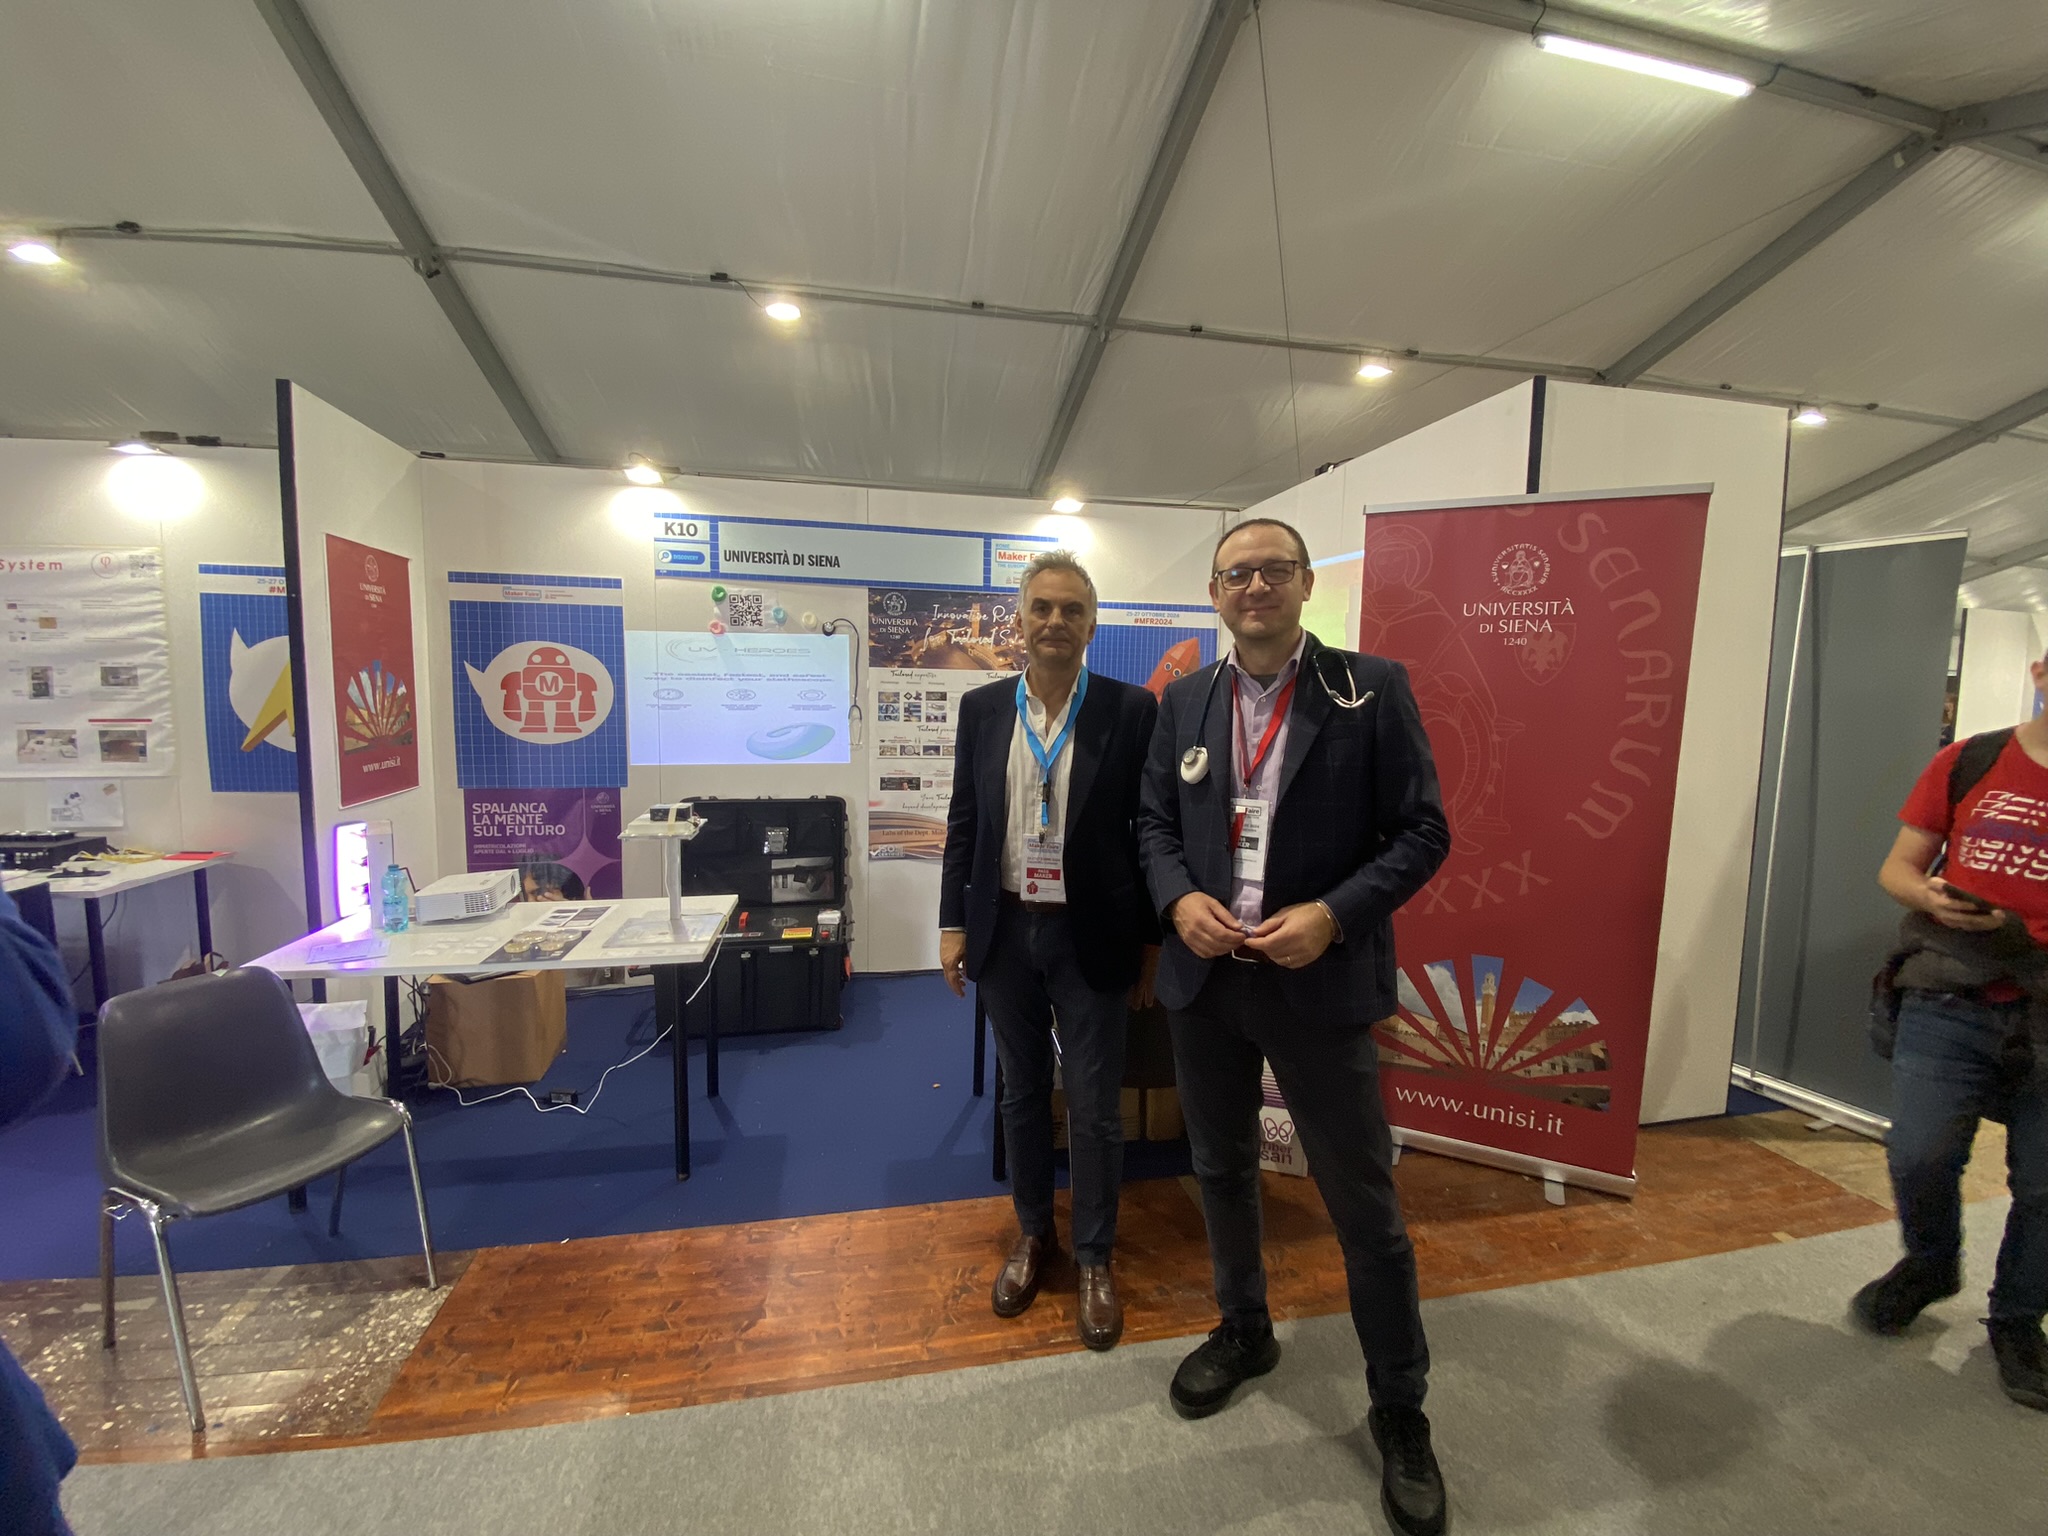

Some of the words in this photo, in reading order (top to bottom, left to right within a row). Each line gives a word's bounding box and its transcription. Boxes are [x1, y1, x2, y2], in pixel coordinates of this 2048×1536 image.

[664, 521, 698, 537] K10
[724, 549, 790, 566] UNIVERSITÀ
[792, 553, 805, 566] DI
[808, 554, 841, 568] SIENA
[998, 551, 1027, 561] Maker
[0, 558, 63, 572] System
[1463, 597, 1575, 617] UNIVERSITÀ
[872, 617, 919, 627] UNIVERSITÀ
[1134, 617, 1173, 625] #MFR2024
[1480, 623, 1493, 634] DI
[1498, 619, 1553, 634] SIENA
[887, 626, 911, 634] SIENA
[1503, 637, 1528, 646] 1240
[539, 675, 560, 692] M
[472, 802, 548, 814] SPALANCA
[473, 814, 491, 825] LA
[494, 813, 544, 825] MENTE
[473, 825, 502, 837] SUL
[506, 824, 566, 836] FUTURO
[1395, 1086, 1565, 1136] www.unisi.it
[1260, 1150, 1292, 1165] san
